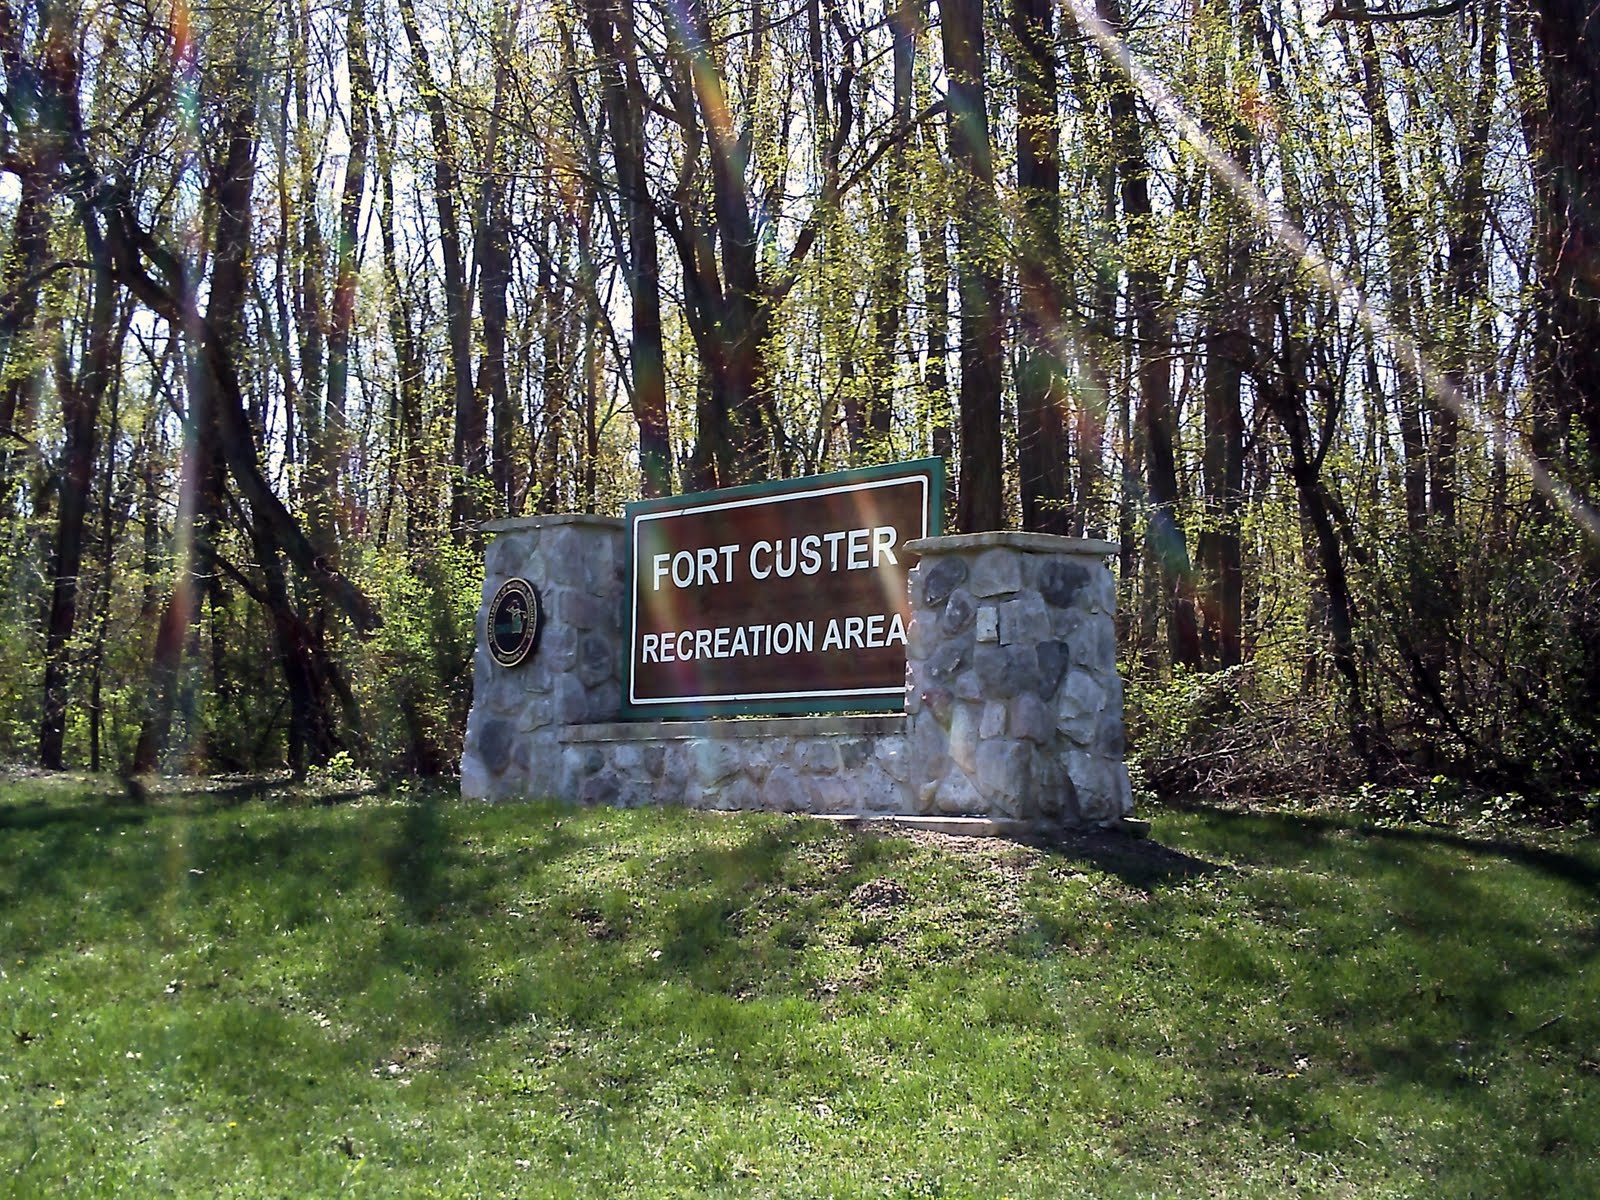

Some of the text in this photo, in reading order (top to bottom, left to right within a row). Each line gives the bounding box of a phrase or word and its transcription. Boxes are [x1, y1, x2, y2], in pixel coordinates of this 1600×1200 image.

[653, 526, 898, 591] FORT CUSTER
[642, 613, 907, 663] RECREATION AREA
